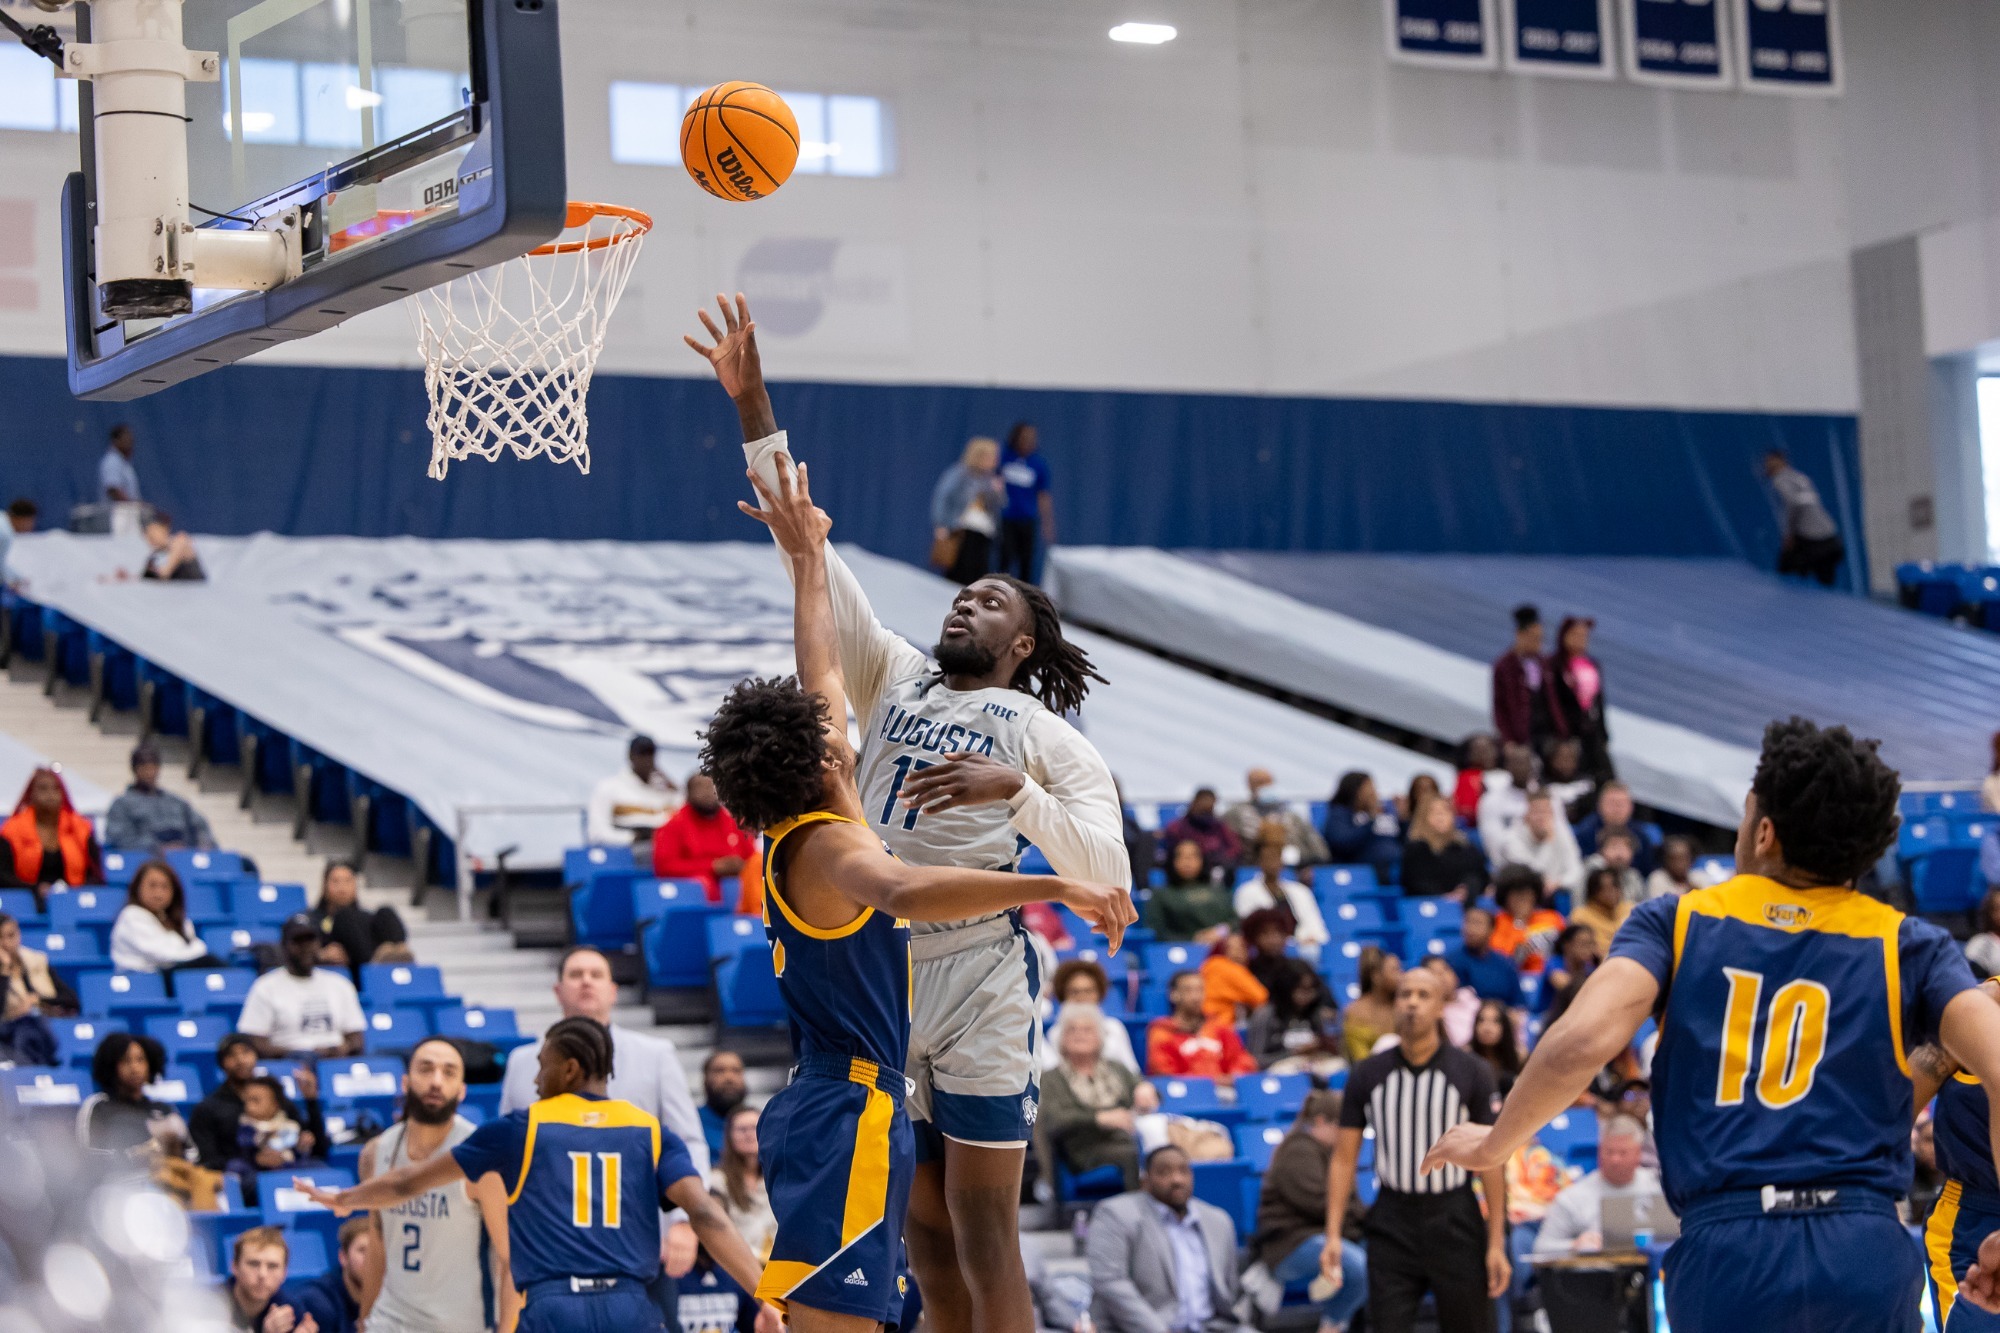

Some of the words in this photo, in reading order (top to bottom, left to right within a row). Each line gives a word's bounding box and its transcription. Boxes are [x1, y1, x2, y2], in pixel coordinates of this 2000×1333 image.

[879, 704, 995, 758] AUGUSTA
[982, 702, 1018, 721] PBC
[1715, 966, 1831, 1110] 10
[390, 1193, 450, 1218] USTA
[567, 1150, 622, 1229] 11
[403, 1222, 421, 1272] 2
[843, 1277, 869, 1287] adidas
